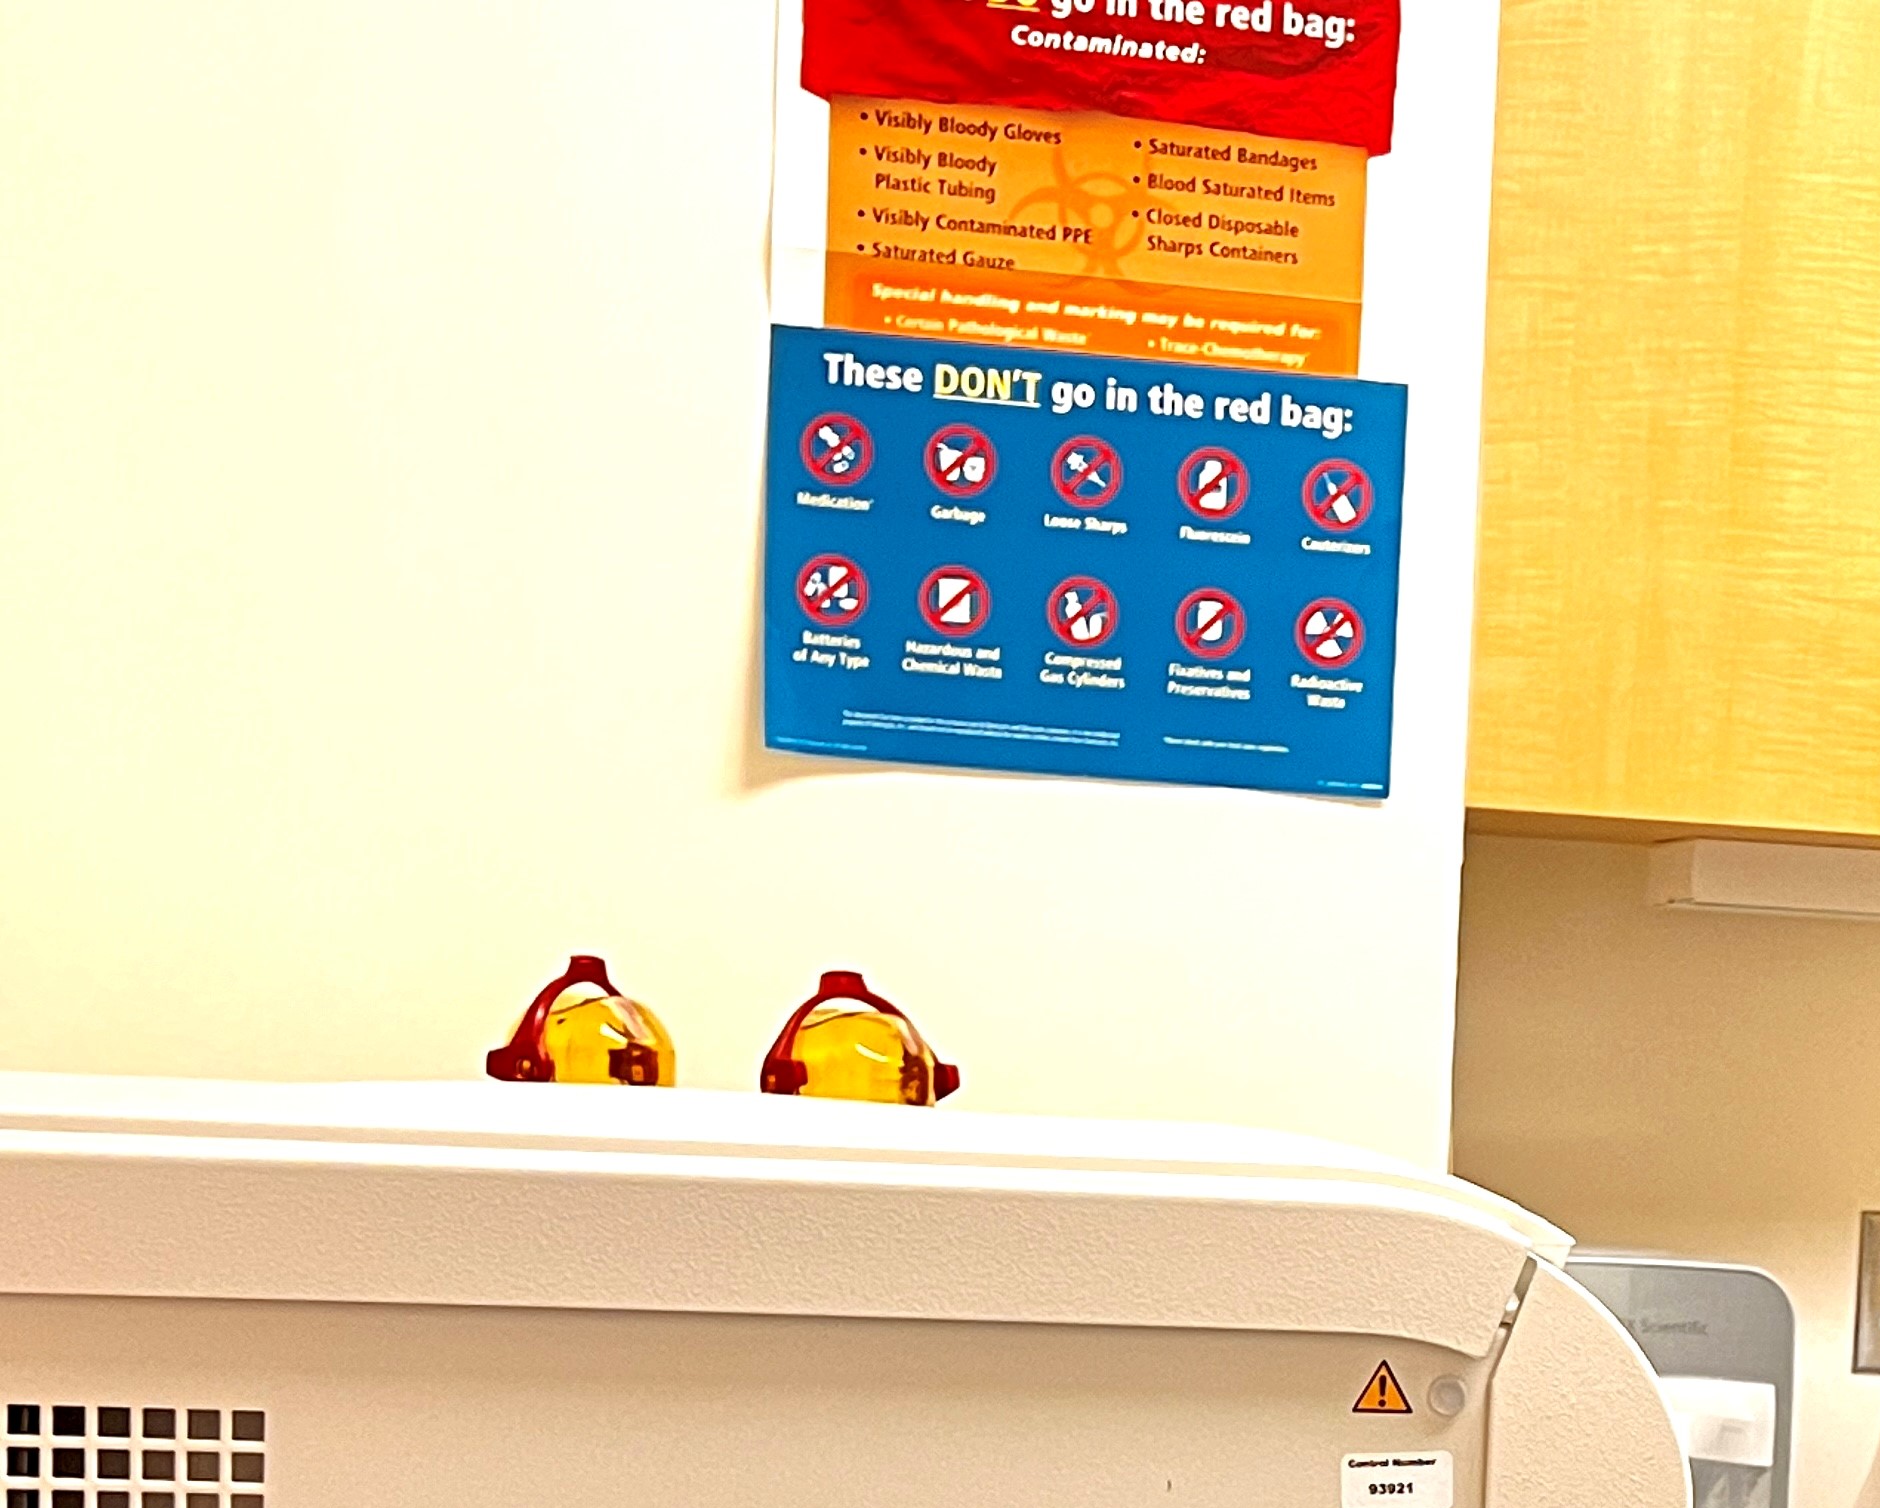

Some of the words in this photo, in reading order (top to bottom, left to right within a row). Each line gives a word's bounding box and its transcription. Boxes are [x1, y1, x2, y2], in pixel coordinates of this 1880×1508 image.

[1149, 0, 1203, 25] the
[1216, 3, 1273, 34] red
[1284, 4, 1356, 48] bag:
[1010, 25, 1206, 65] Contaminated:
[875, 109, 932, 135] Visibly
[939, 116, 998, 142] Bloody
[1004, 123, 1062, 145] Gloves
[874, 145, 932, 170] Visibly
[938, 152, 998, 177] Bloody
[1149, 138, 1231, 161] Saturated
[1238, 148, 1317, 172] Bandages
[875, 173, 931, 194] Plastic
[939, 179, 996, 204] Tubing
[1147, 173, 1196, 193] Blood
[1202, 179, 1284, 202] Saturated
[1290, 188, 1336, 207] Items
[872, 207, 930, 232] Visibly
[936, 214, 1056, 241] Contaminated
[1062, 227, 1093, 244] PPE
[1146, 208, 1202, 228] Closed
[1208, 214, 1299, 237] Disposable
[872, 242, 956, 265] Saturated
[963, 251, 1015, 271] Gauze
[1147, 235, 1203, 258] Sharps
[1210, 242, 1298, 265] Containers
[872, 283, 936, 301] Special
[940, 289, 1021, 314] handling
[1026, 300, 1060, 314] and
[1064, 304, 1137, 325] marking
[1142, 312, 1179, 329] may
[1183, 313, 1205, 328] be
[1210, 320, 1287, 336] required
[823, 353, 923, 393] These
[934, 364, 1041, 405] DON'T
[1051, 380, 1096, 413] go
[1106, 378, 1137, 412] in
[1147, 385, 1203, 420] the
[1214, 392, 1272, 426] red
[1280, 398, 1354, 440] bag:
[930, 505, 986, 525] Garbage
[1044, 514, 1081, 530] Loose
[1085, 517, 1127, 535] Sharps
[803, 631, 861, 649] Batteries
[906, 641, 972, 658] Hazardous
[976, 647, 1000, 661] and
[792, 649, 808, 663] of
[810, 650, 836, 667] Any
[840, 652, 870, 669] Type
[902, 657, 960, 675] Chemical
[963, 664, 1002, 679] Waste
[1045, 652, 1122, 670] Compressed
[1040, 670, 1064, 685] Gas
[1067, 671, 1125, 689] Cylinders
[1226, 669, 1251, 682] and
[1368, 1482, 1413, 1495] 93921
